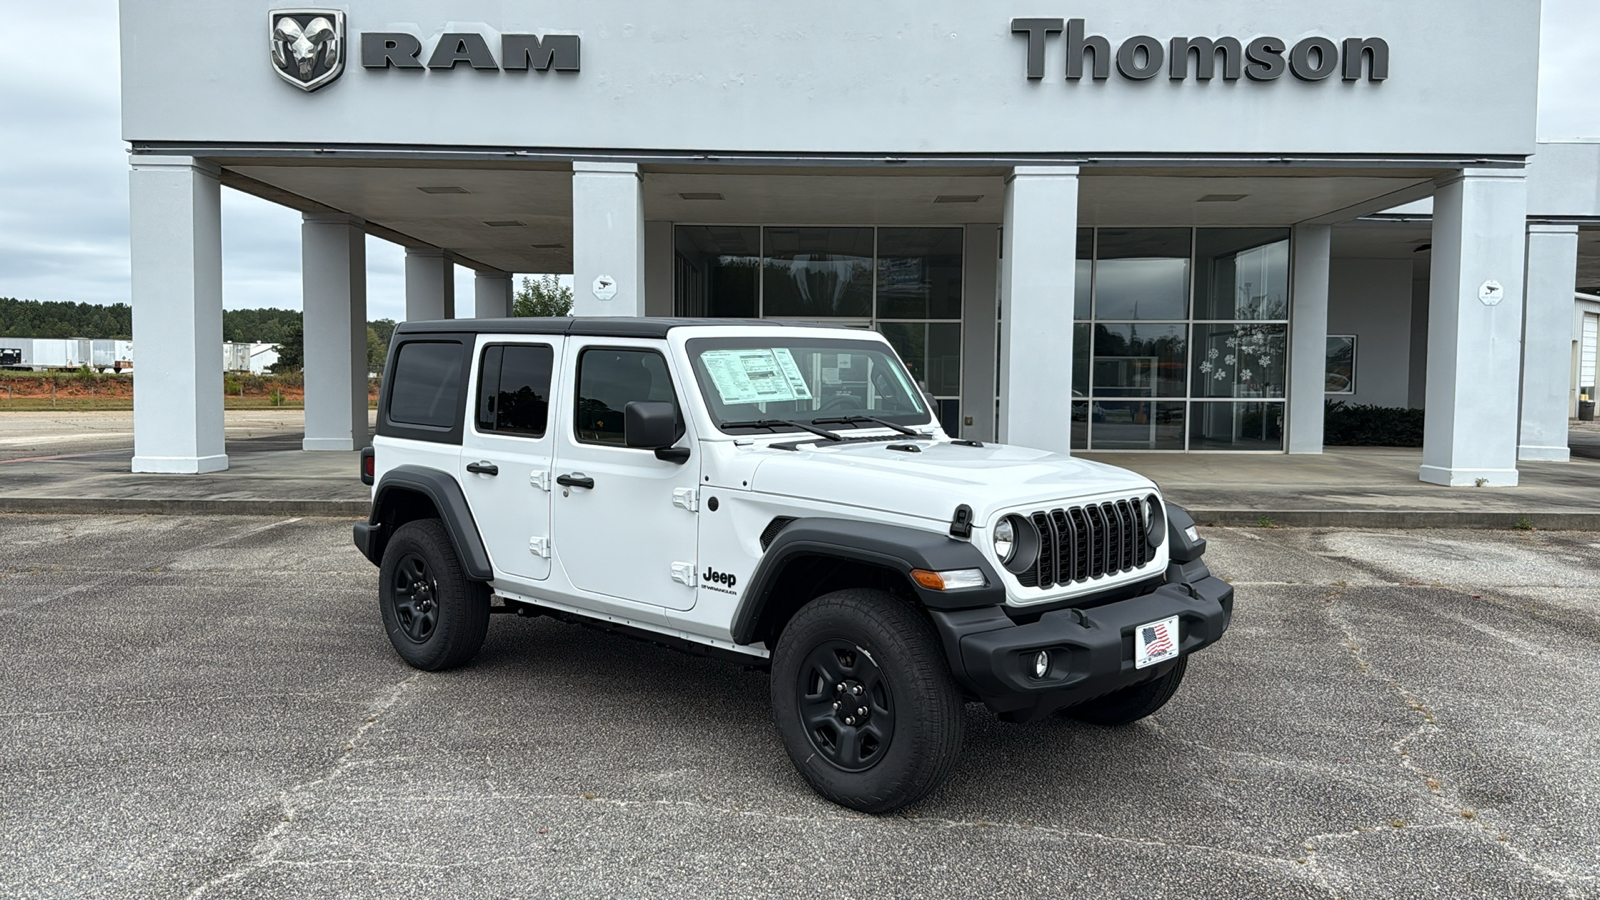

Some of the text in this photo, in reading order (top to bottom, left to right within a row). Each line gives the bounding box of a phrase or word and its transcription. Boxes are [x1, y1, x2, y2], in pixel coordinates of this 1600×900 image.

[361, 32, 581, 72] RAM
[1011, 18, 1390, 82] Thomson
[703, 566, 737, 588] Jeep
[706, 585, 738, 596] WRANGLER
